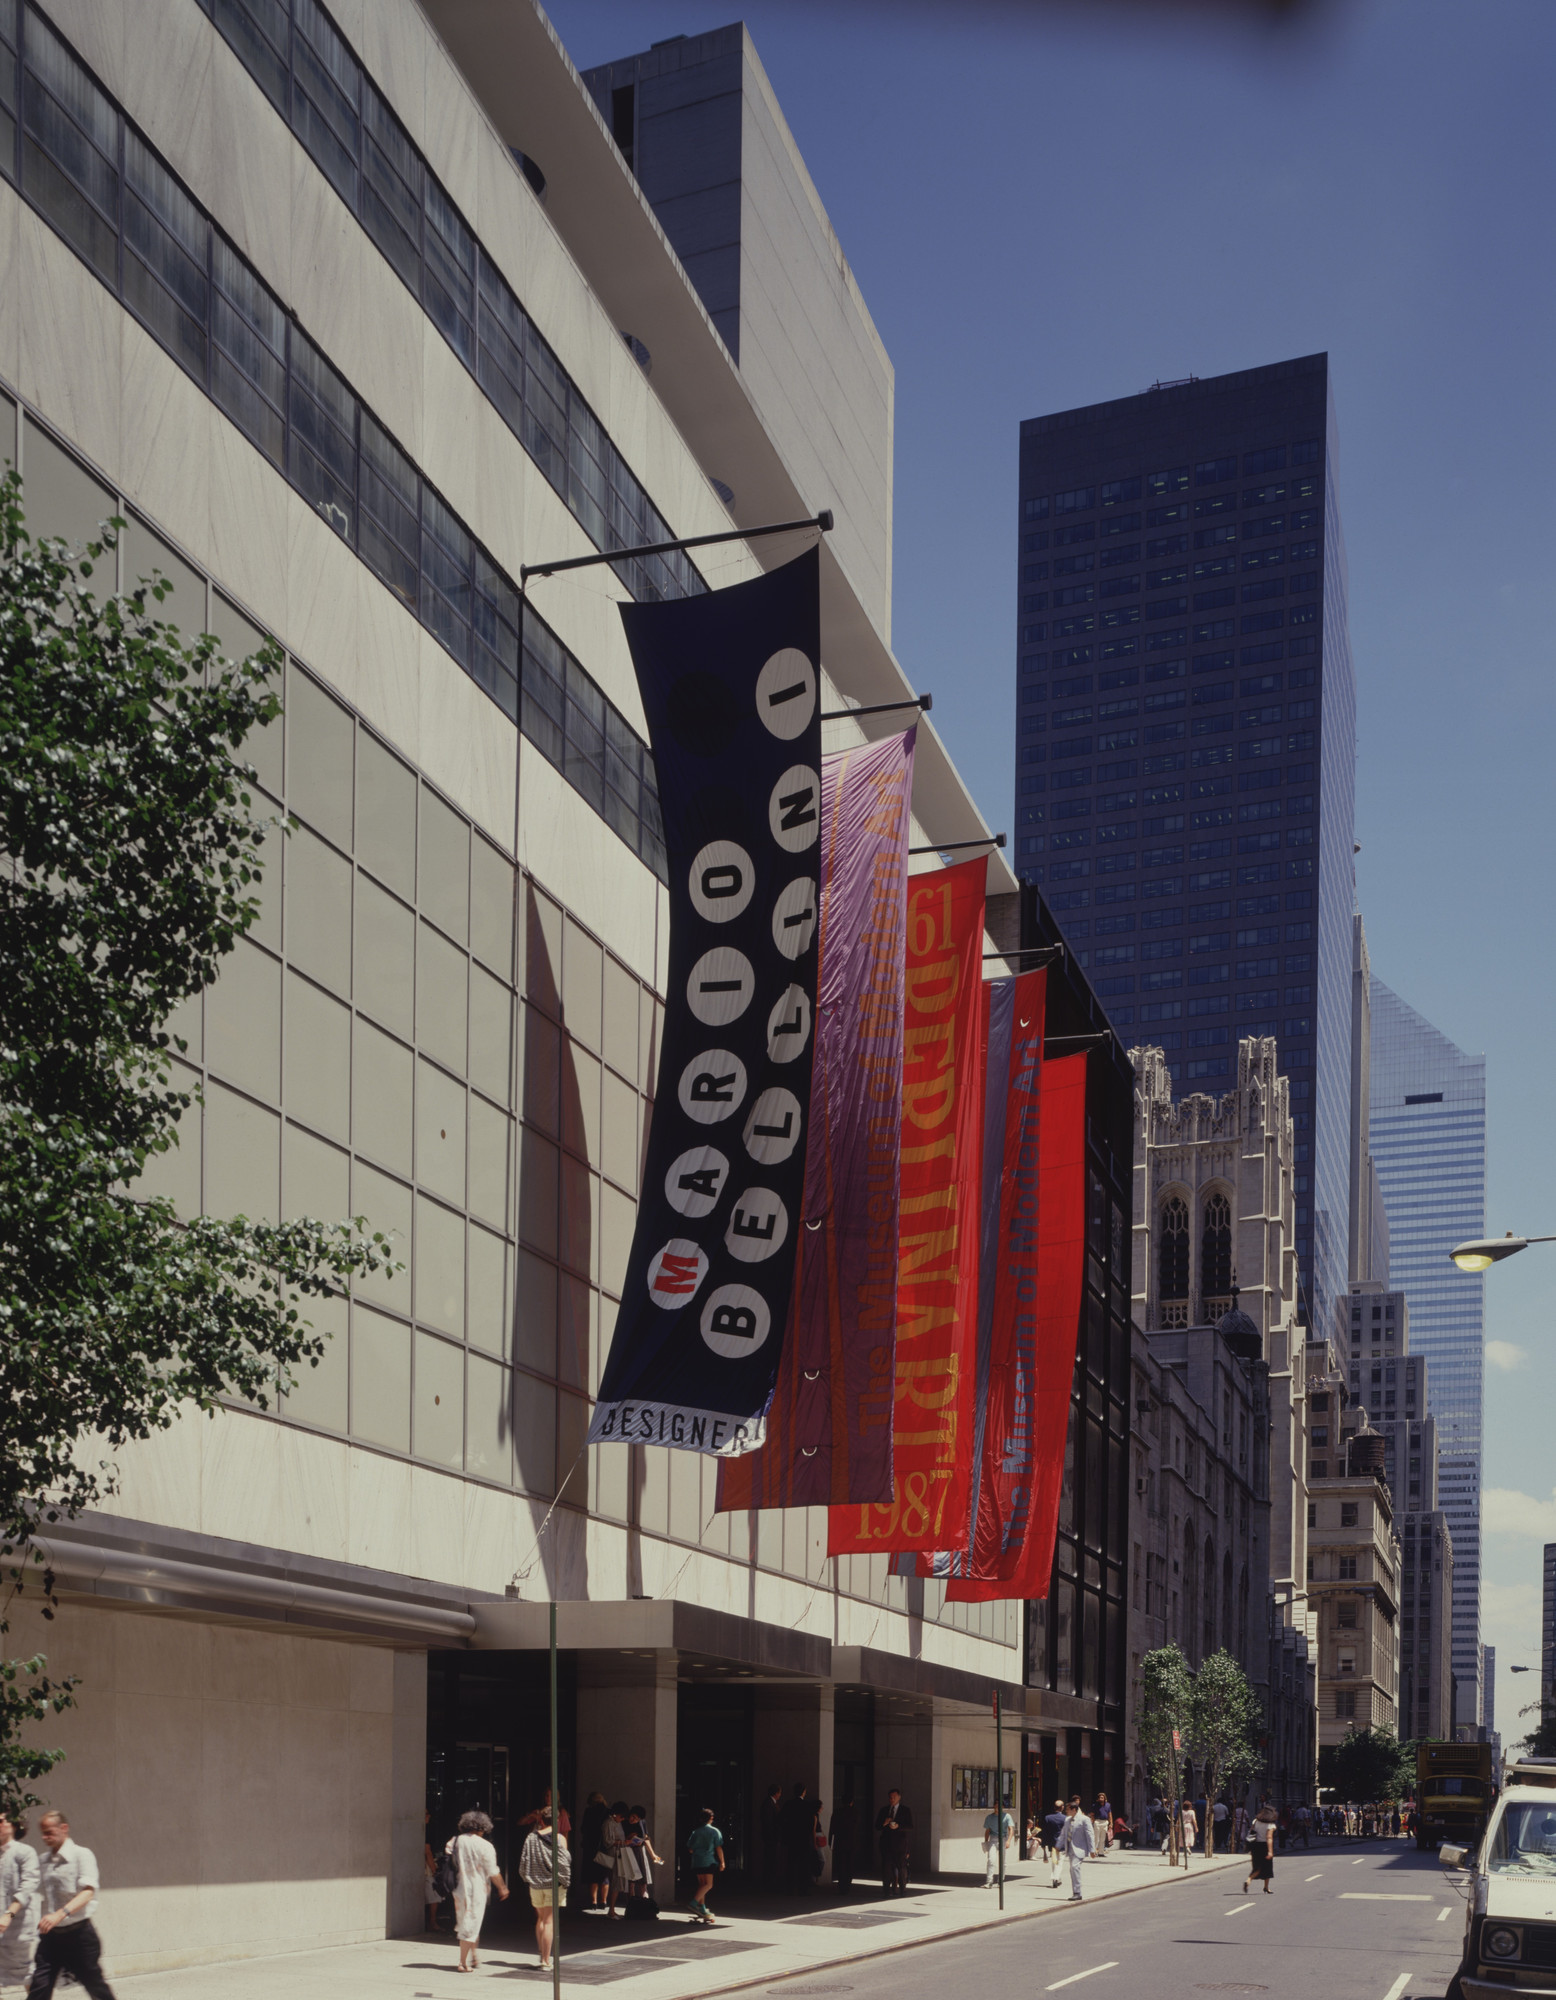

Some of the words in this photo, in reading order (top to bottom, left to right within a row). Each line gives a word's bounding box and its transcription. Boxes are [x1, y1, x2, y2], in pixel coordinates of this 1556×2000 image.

[864, 769, 905, 841] Art
[858, 851, 902, 1039] Modern
[907, 882, 956, 957] 61
[711, 680, 817, 1339] BELLINI
[654, 865, 742, 1294] MARIO
[858, 1053, 898, 1102] of
[1012, 1035, 1042, 1096] Art
[1009, 1106, 1041, 1253] Modern
[857, 1117, 898, 1331] Museum
[1008, 1262, 1040, 1300] of
[860, 1345, 894, 1436] The
[1002, 1312, 1038, 1474] Museum
[856, 1470, 953, 1540] 1987
[1001, 1484, 1031, 1555] The
